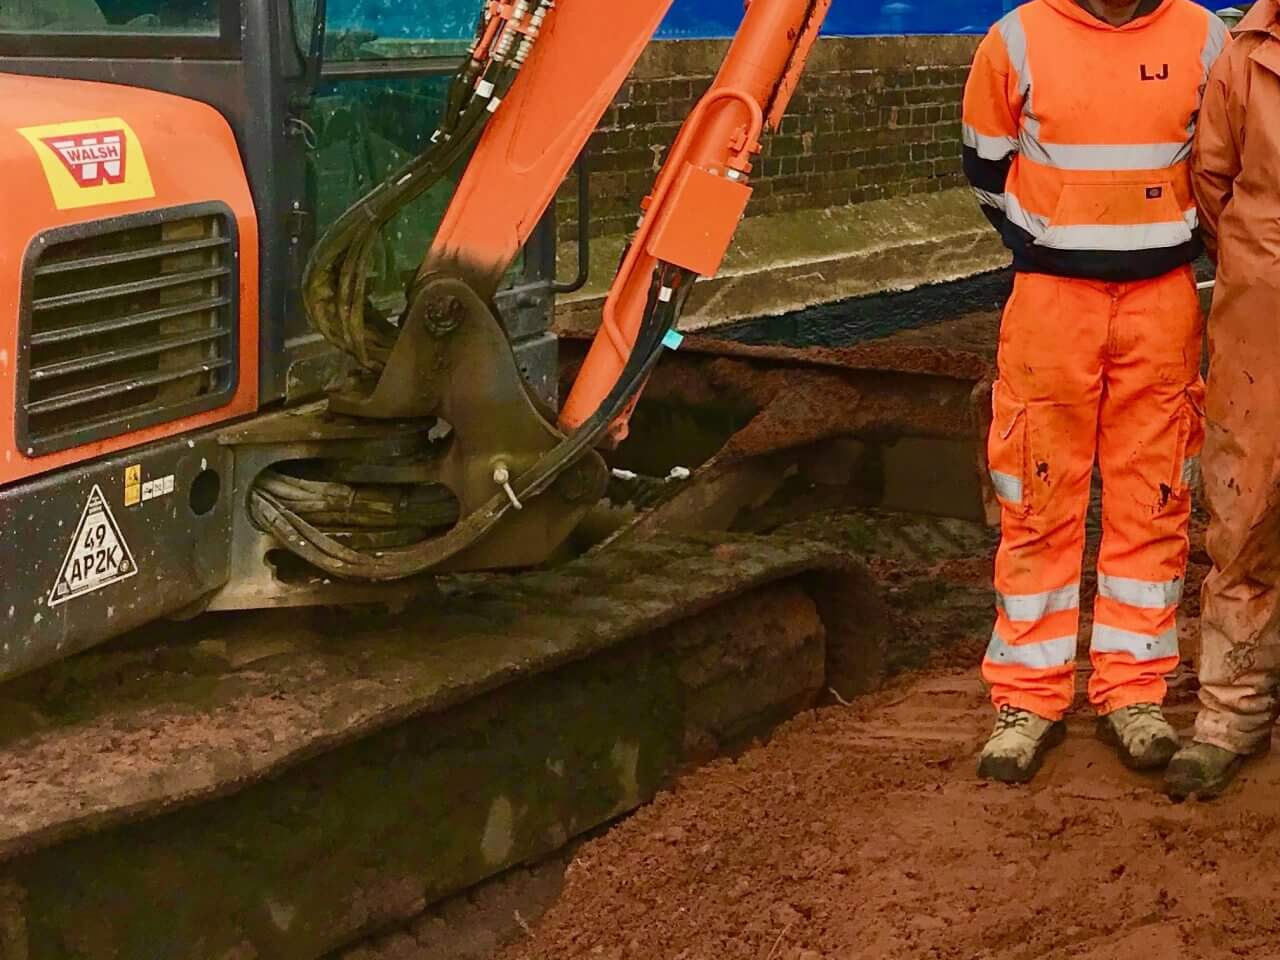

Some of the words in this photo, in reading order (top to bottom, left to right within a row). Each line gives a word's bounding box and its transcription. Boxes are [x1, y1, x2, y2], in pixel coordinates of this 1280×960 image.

[1140, 64, 1169, 81] LJ
[67, 145, 118, 162] WALSH
[84, 523, 106, 550] 49
[70, 545, 118, 584] AP2K
